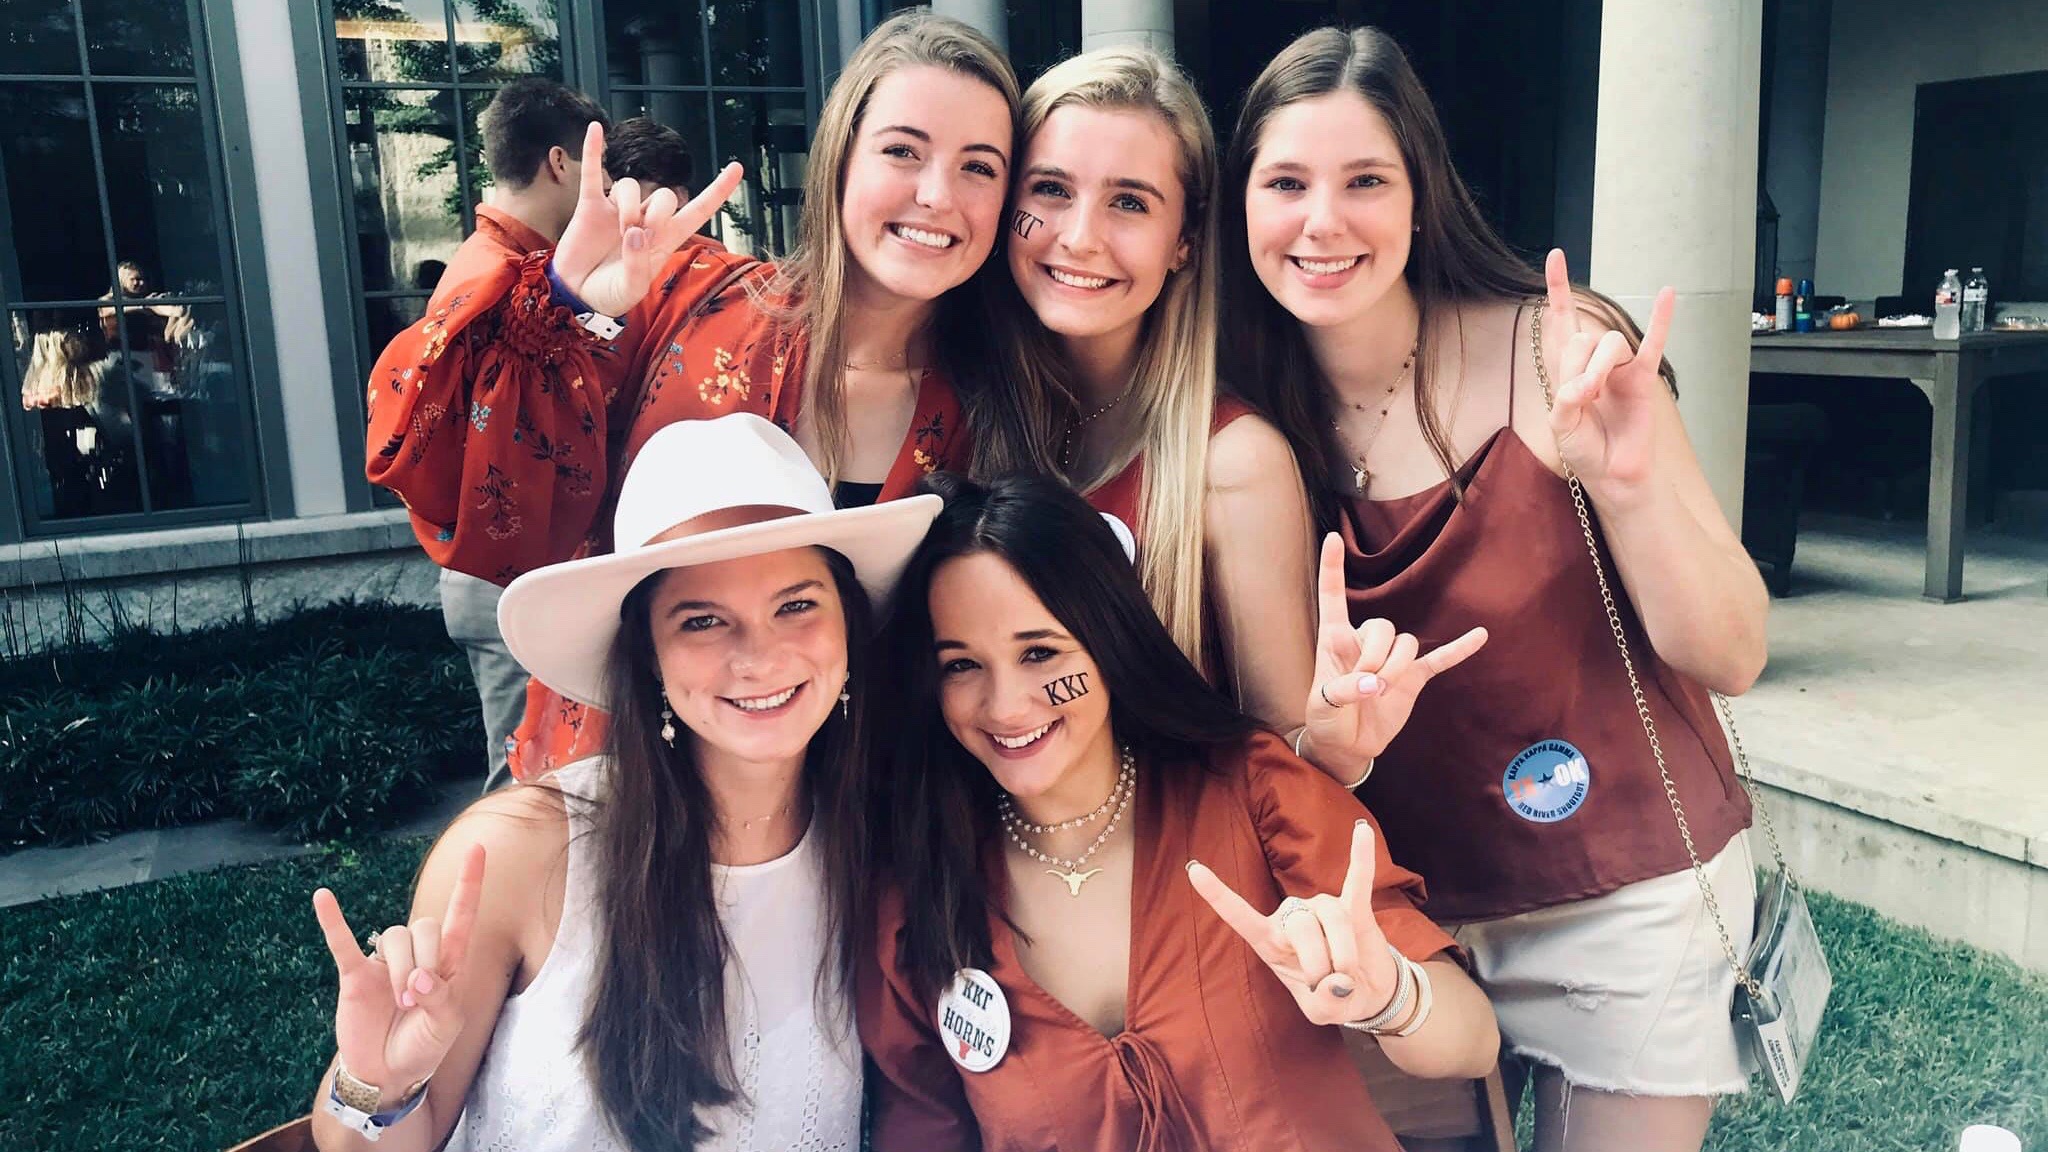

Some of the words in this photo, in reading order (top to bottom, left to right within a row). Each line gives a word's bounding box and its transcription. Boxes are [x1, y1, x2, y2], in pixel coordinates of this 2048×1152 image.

[1508, 758, 1525, 780] KAPPA
[1523, 743, 1547, 760] KAPPA
[1548, 743, 1575, 759] GAMMA
[1554, 757, 1587, 787] OK
[1518, 801, 1533, 815] RED
[1533, 810, 1556, 819] RIVER
[1556, 782, 1585, 815] SHOOTOUT
[943, 1007, 995, 1057] HORNS
